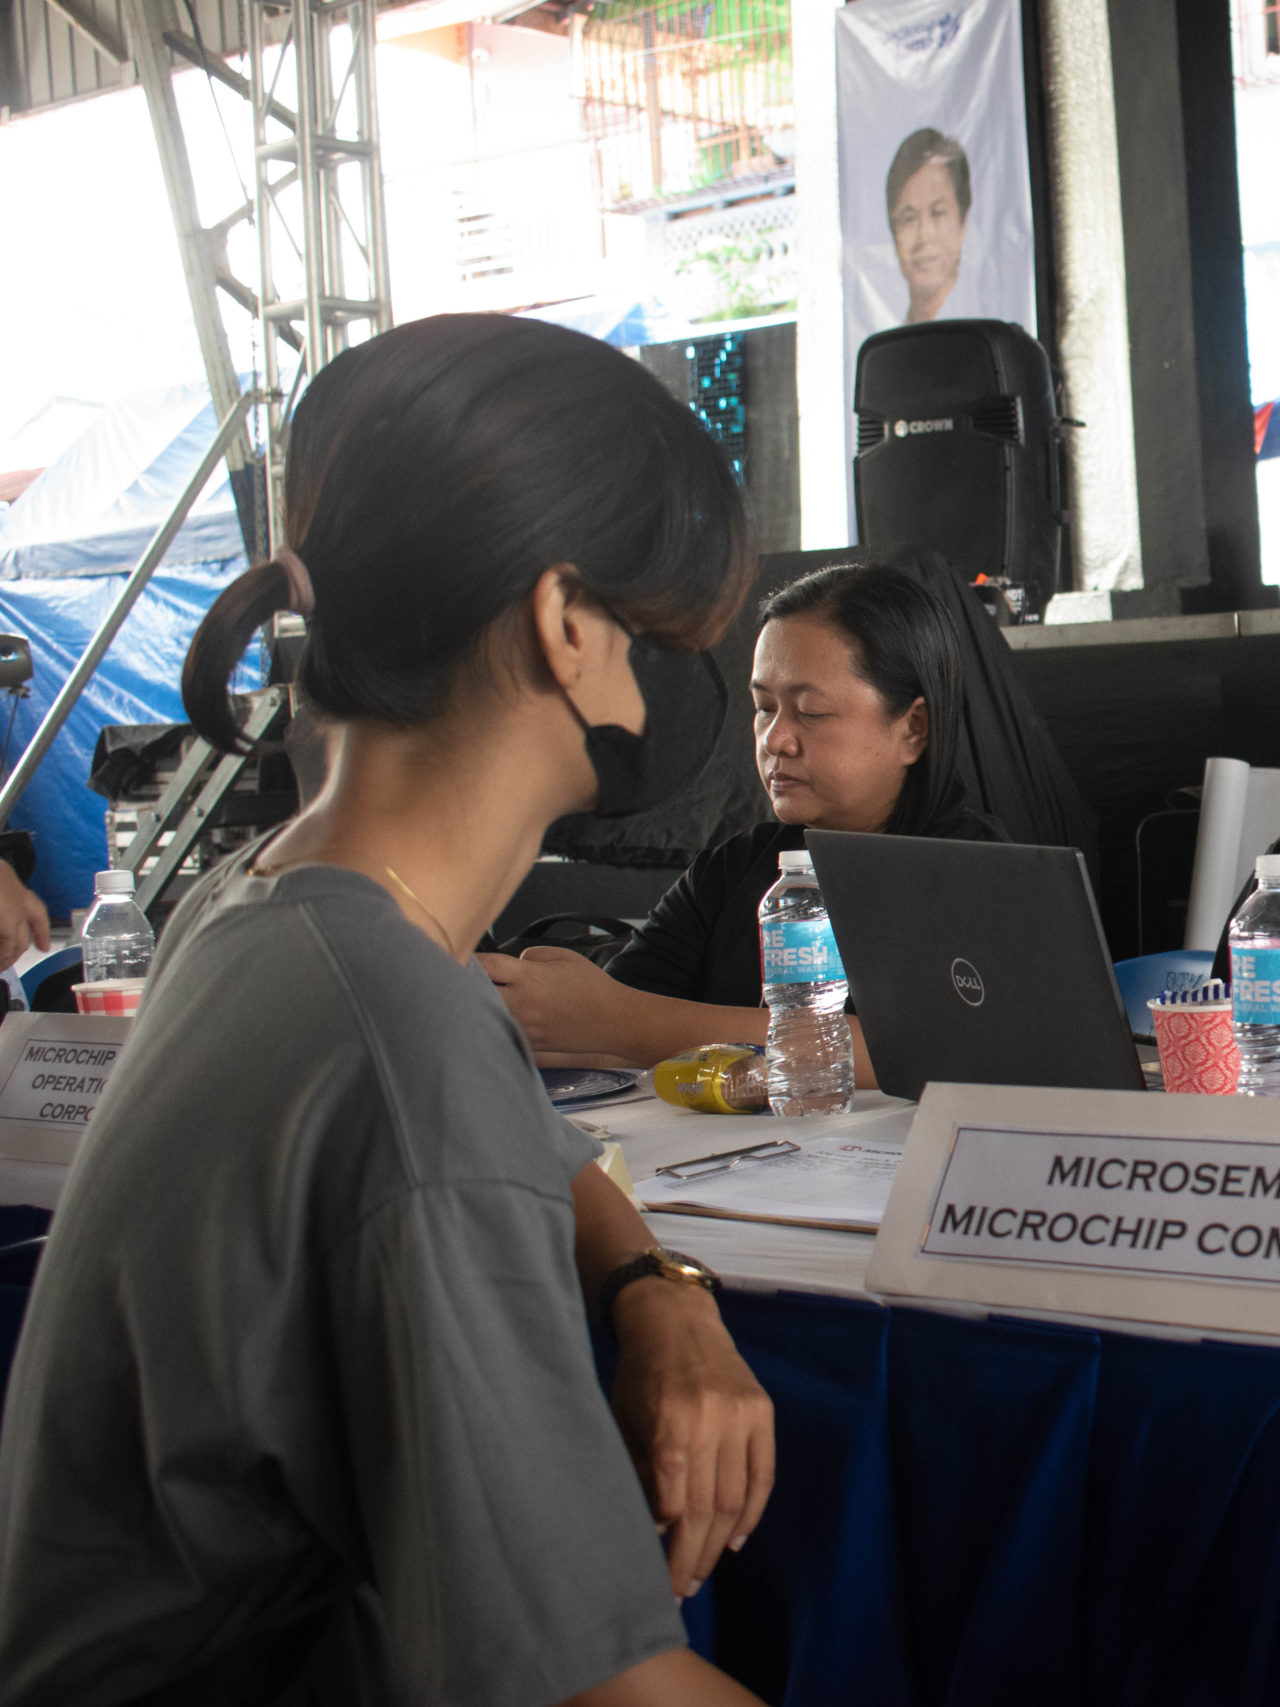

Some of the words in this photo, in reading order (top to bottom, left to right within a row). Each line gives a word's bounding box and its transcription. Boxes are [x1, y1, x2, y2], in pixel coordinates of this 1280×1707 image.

[909, 419, 953, 434] CROWN
[764, 946, 828, 967] FRESH
[1232, 955, 1255, 979] RE
[25, 1046, 117, 1066] MICROCHIP
[939, 1203, 1188, 1253] MICROCHIP
